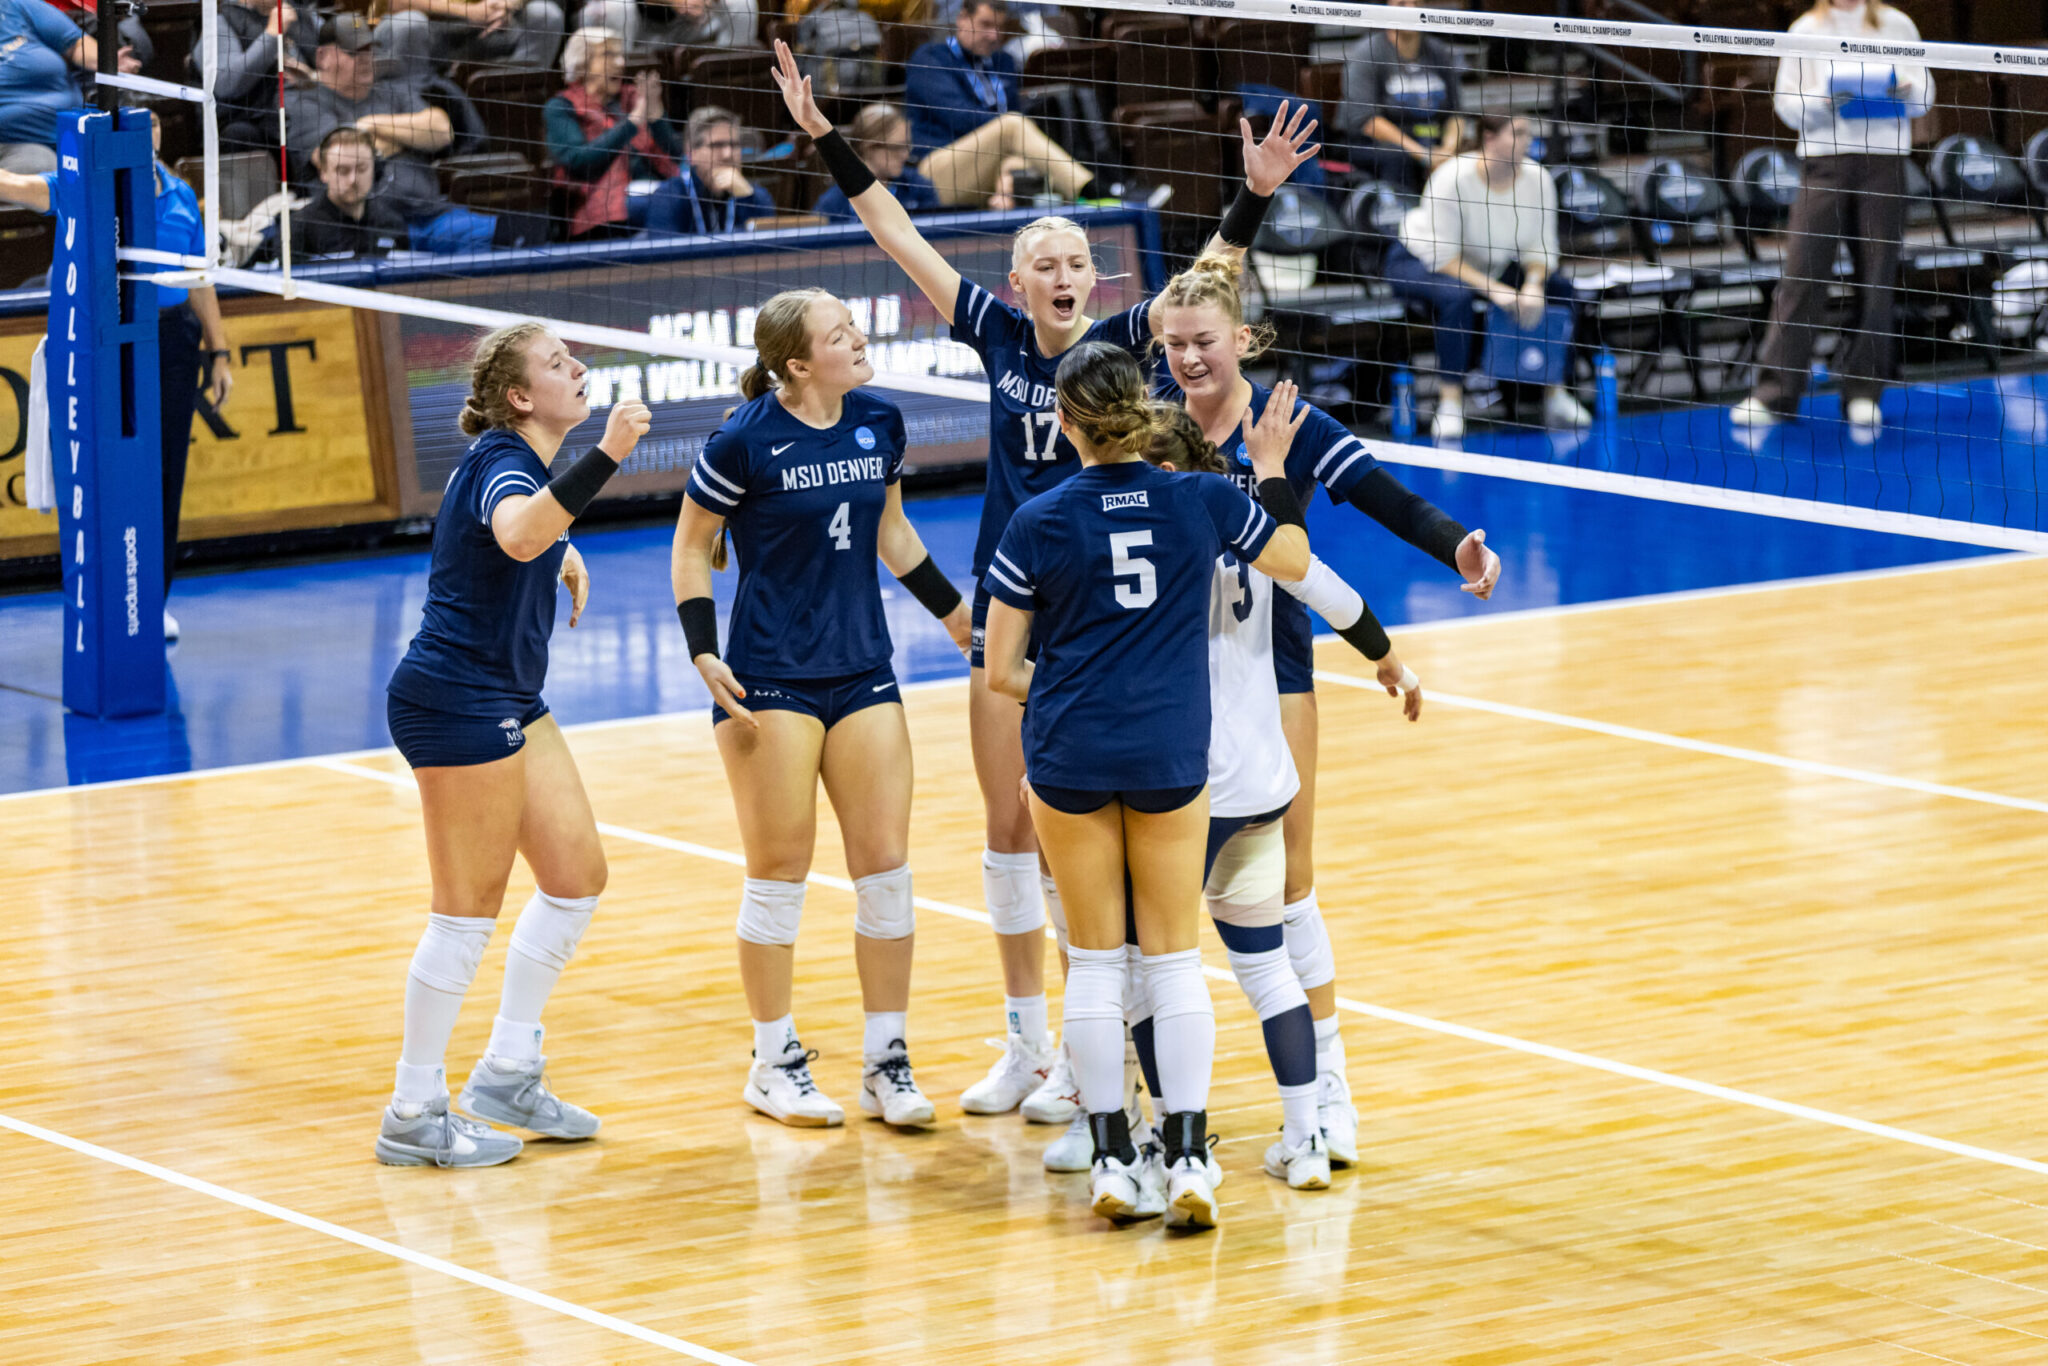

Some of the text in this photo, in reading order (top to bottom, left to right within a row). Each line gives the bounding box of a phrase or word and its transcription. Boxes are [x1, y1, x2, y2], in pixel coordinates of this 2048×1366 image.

[1298, 6, 1361, 17] VOLLEYBALL CHAMPIONSHIP
[1428, 15, 1494, 26] VOLLEYBALL CHAMPIONSHIP
[1562, 24, 1632, 36] VOLLEYBALL CHAMPIONSHIP
[1702, 34, 1775, 47] VOLLEYBALL CHAMPIONSHIP
[1849, 44, 1926, 56] VOLLEYBALL CHAMPIONSHIP
[2003, 54, 2037, 65] VOLLEYBALL
[996, 369, 1029, 403] MSU
[65, 216, 85, 653] VOLLEYBALL
[1021, 412, 1061, 460] 17
[782, 457, 884, 490] MSU DENVER
[1106, 493, 1146, 508] RMAC
[828, 502, 851, 550] 4
[1109, 530, 1157, 609] 5
